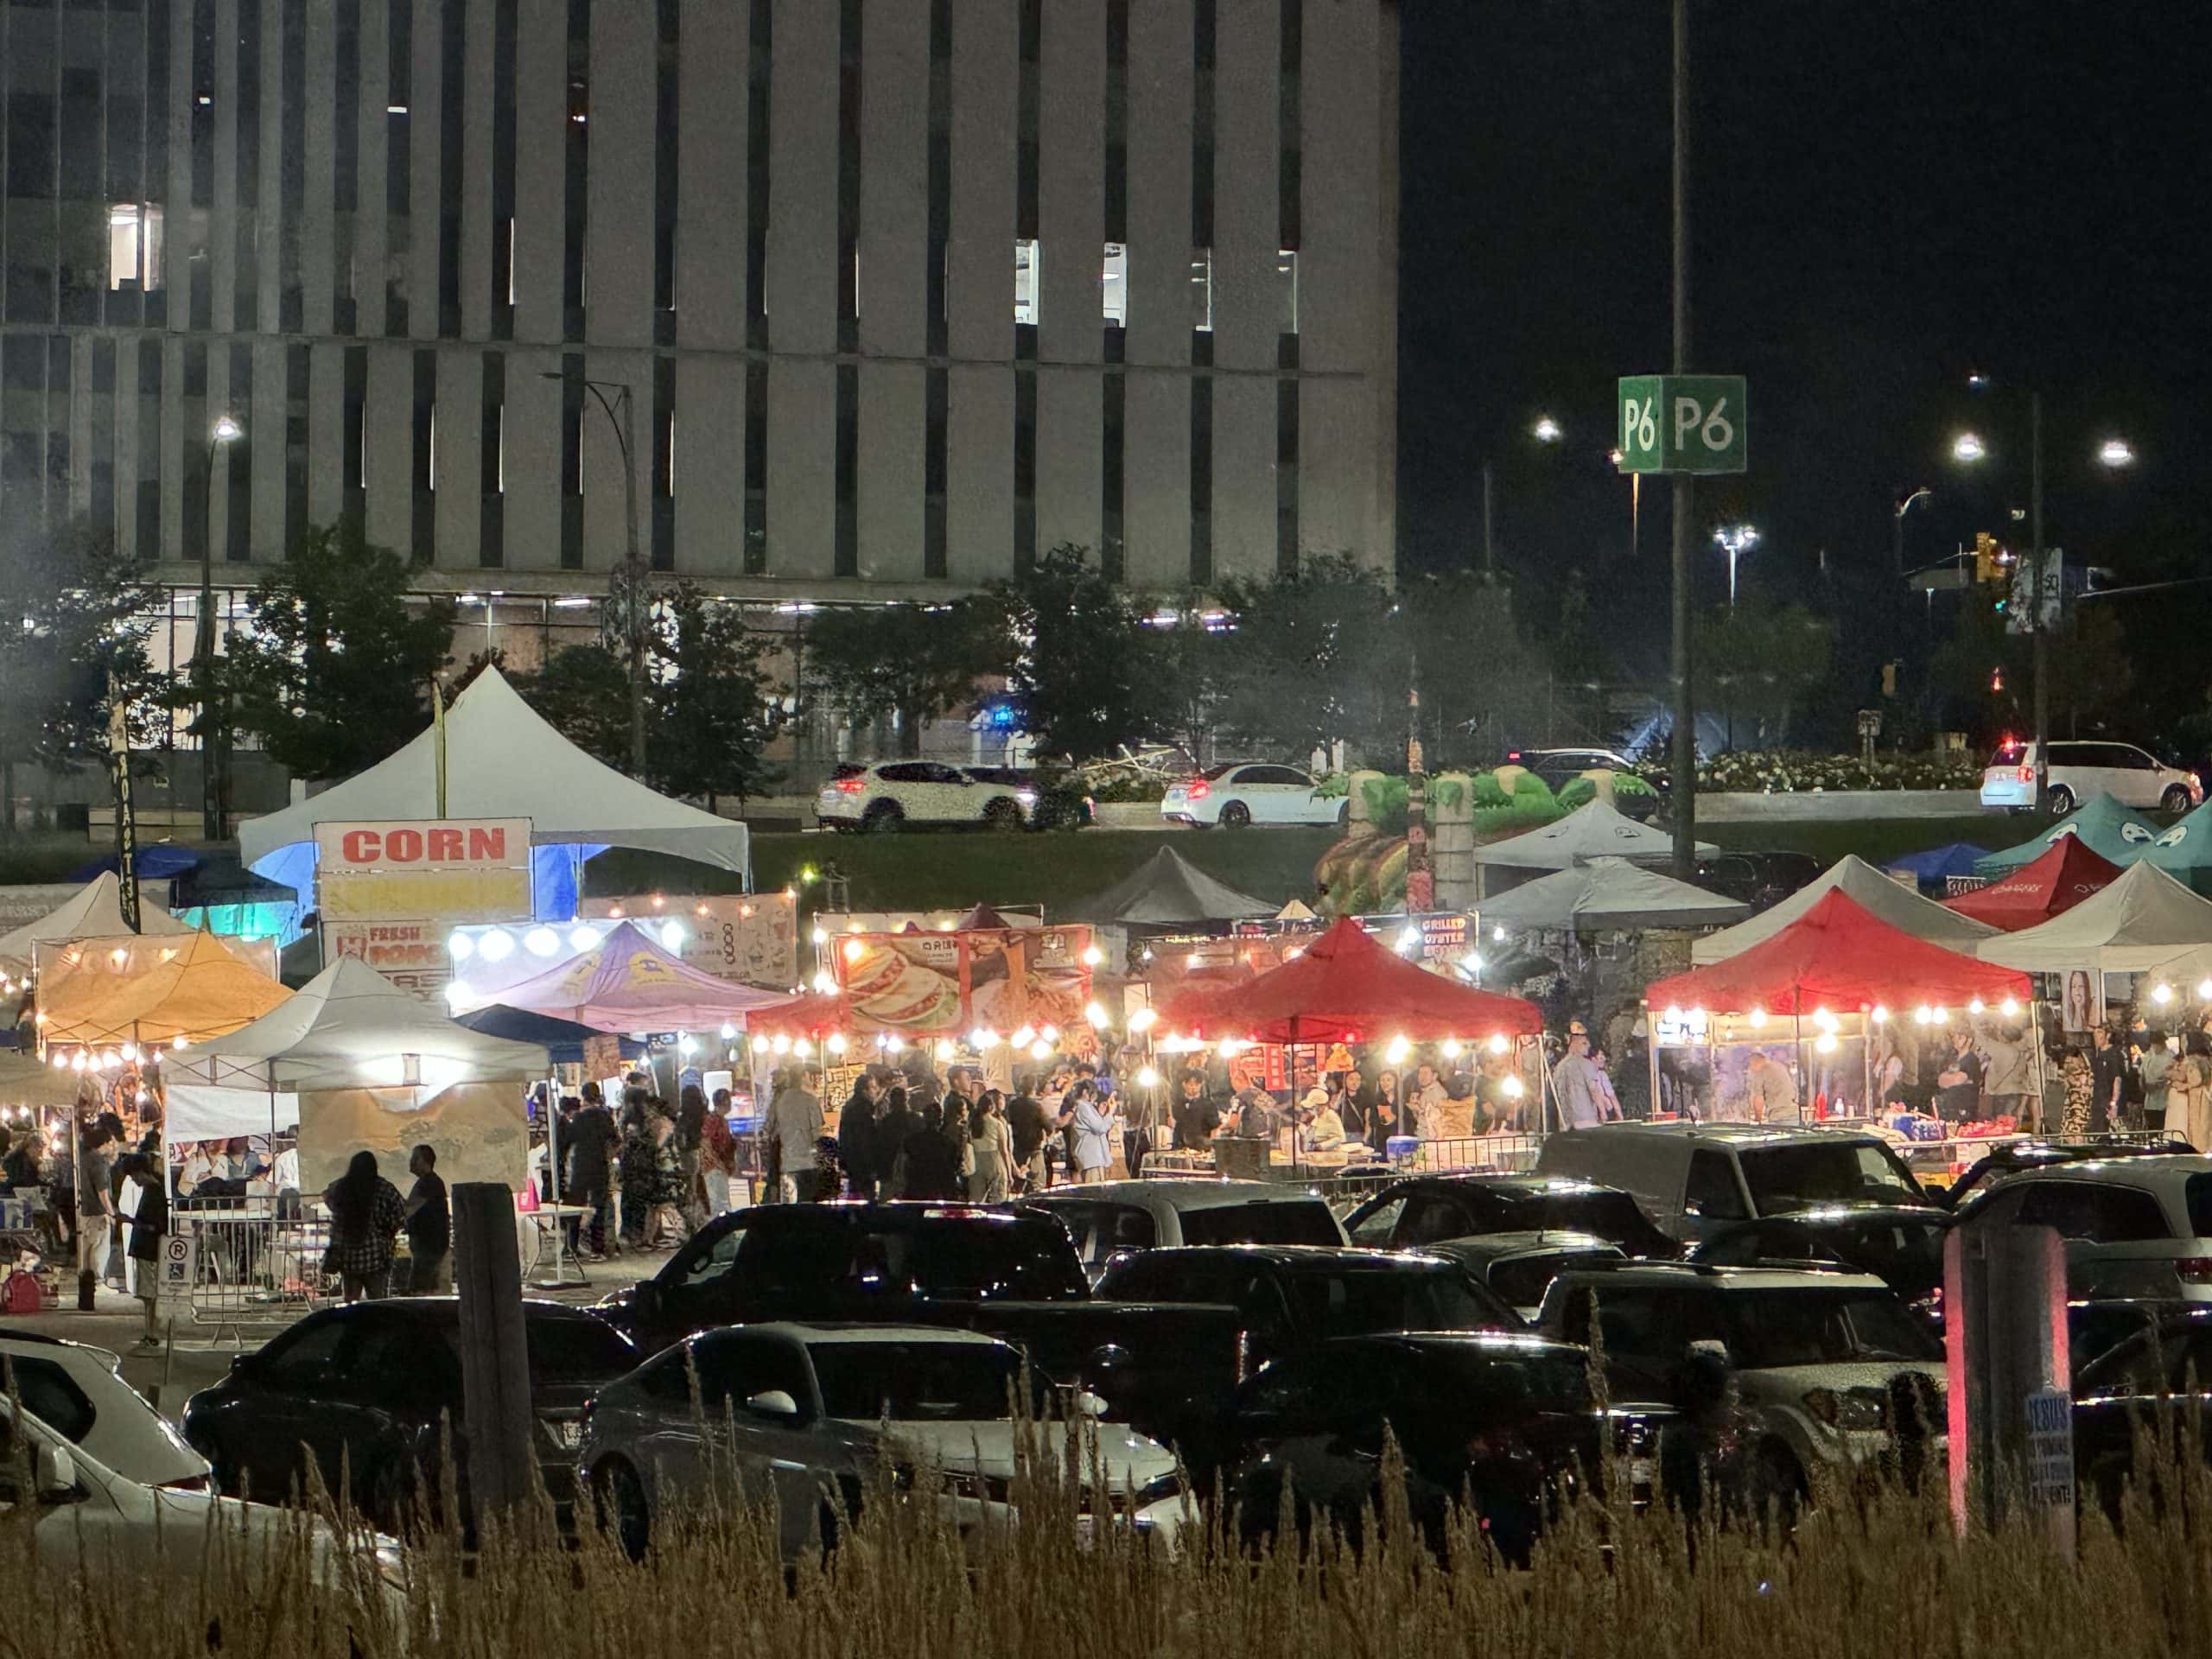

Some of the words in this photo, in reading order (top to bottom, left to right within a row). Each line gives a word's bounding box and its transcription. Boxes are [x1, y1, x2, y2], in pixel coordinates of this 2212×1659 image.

[1624, 397, 1655, 451] P6
[1675, 397, 1733, 450] P6
[342, 827, 505, 862] CORN
[369, 926, 421, 941] FRESH
